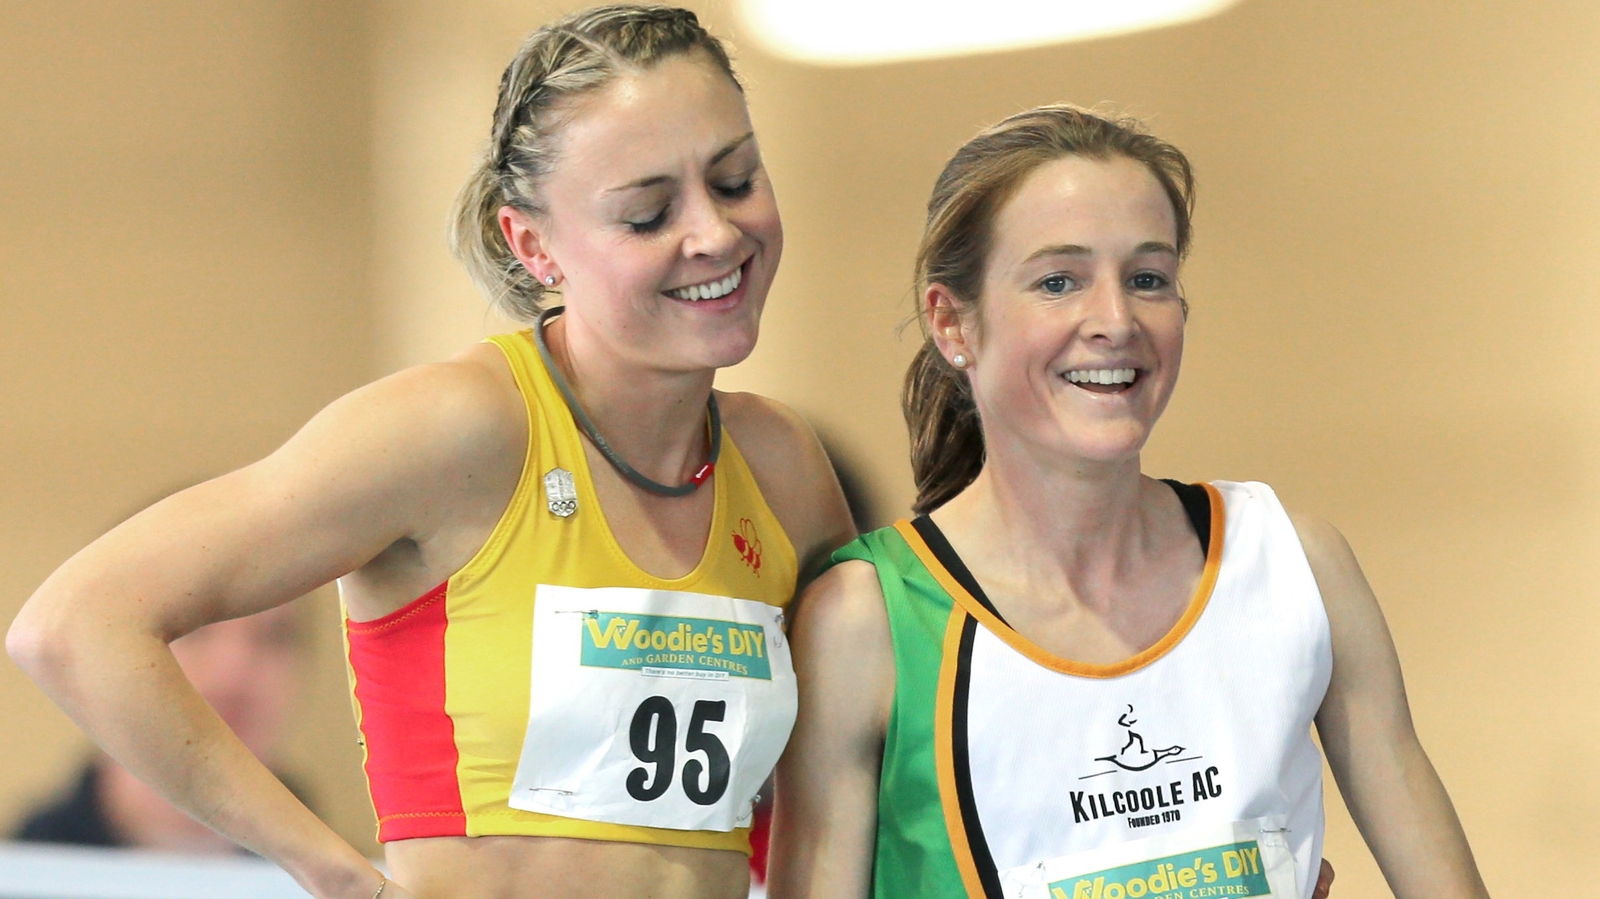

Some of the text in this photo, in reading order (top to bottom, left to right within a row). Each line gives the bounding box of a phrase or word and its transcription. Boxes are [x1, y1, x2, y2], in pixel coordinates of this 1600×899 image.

[585, 616, 764, 658] Woodie's DIY
[621, 653, 748, 675] AND GARDEN CENTRES
[625, 695, 731, 806] 95
[1069, 765, 1222, 824] KILCOOLE AC
[1127, 809, 1181, 829] FOUNDED 1970
[1222, 847, 1259, 879] DIY
[1189, 884, 1250, 899] CENTRES
